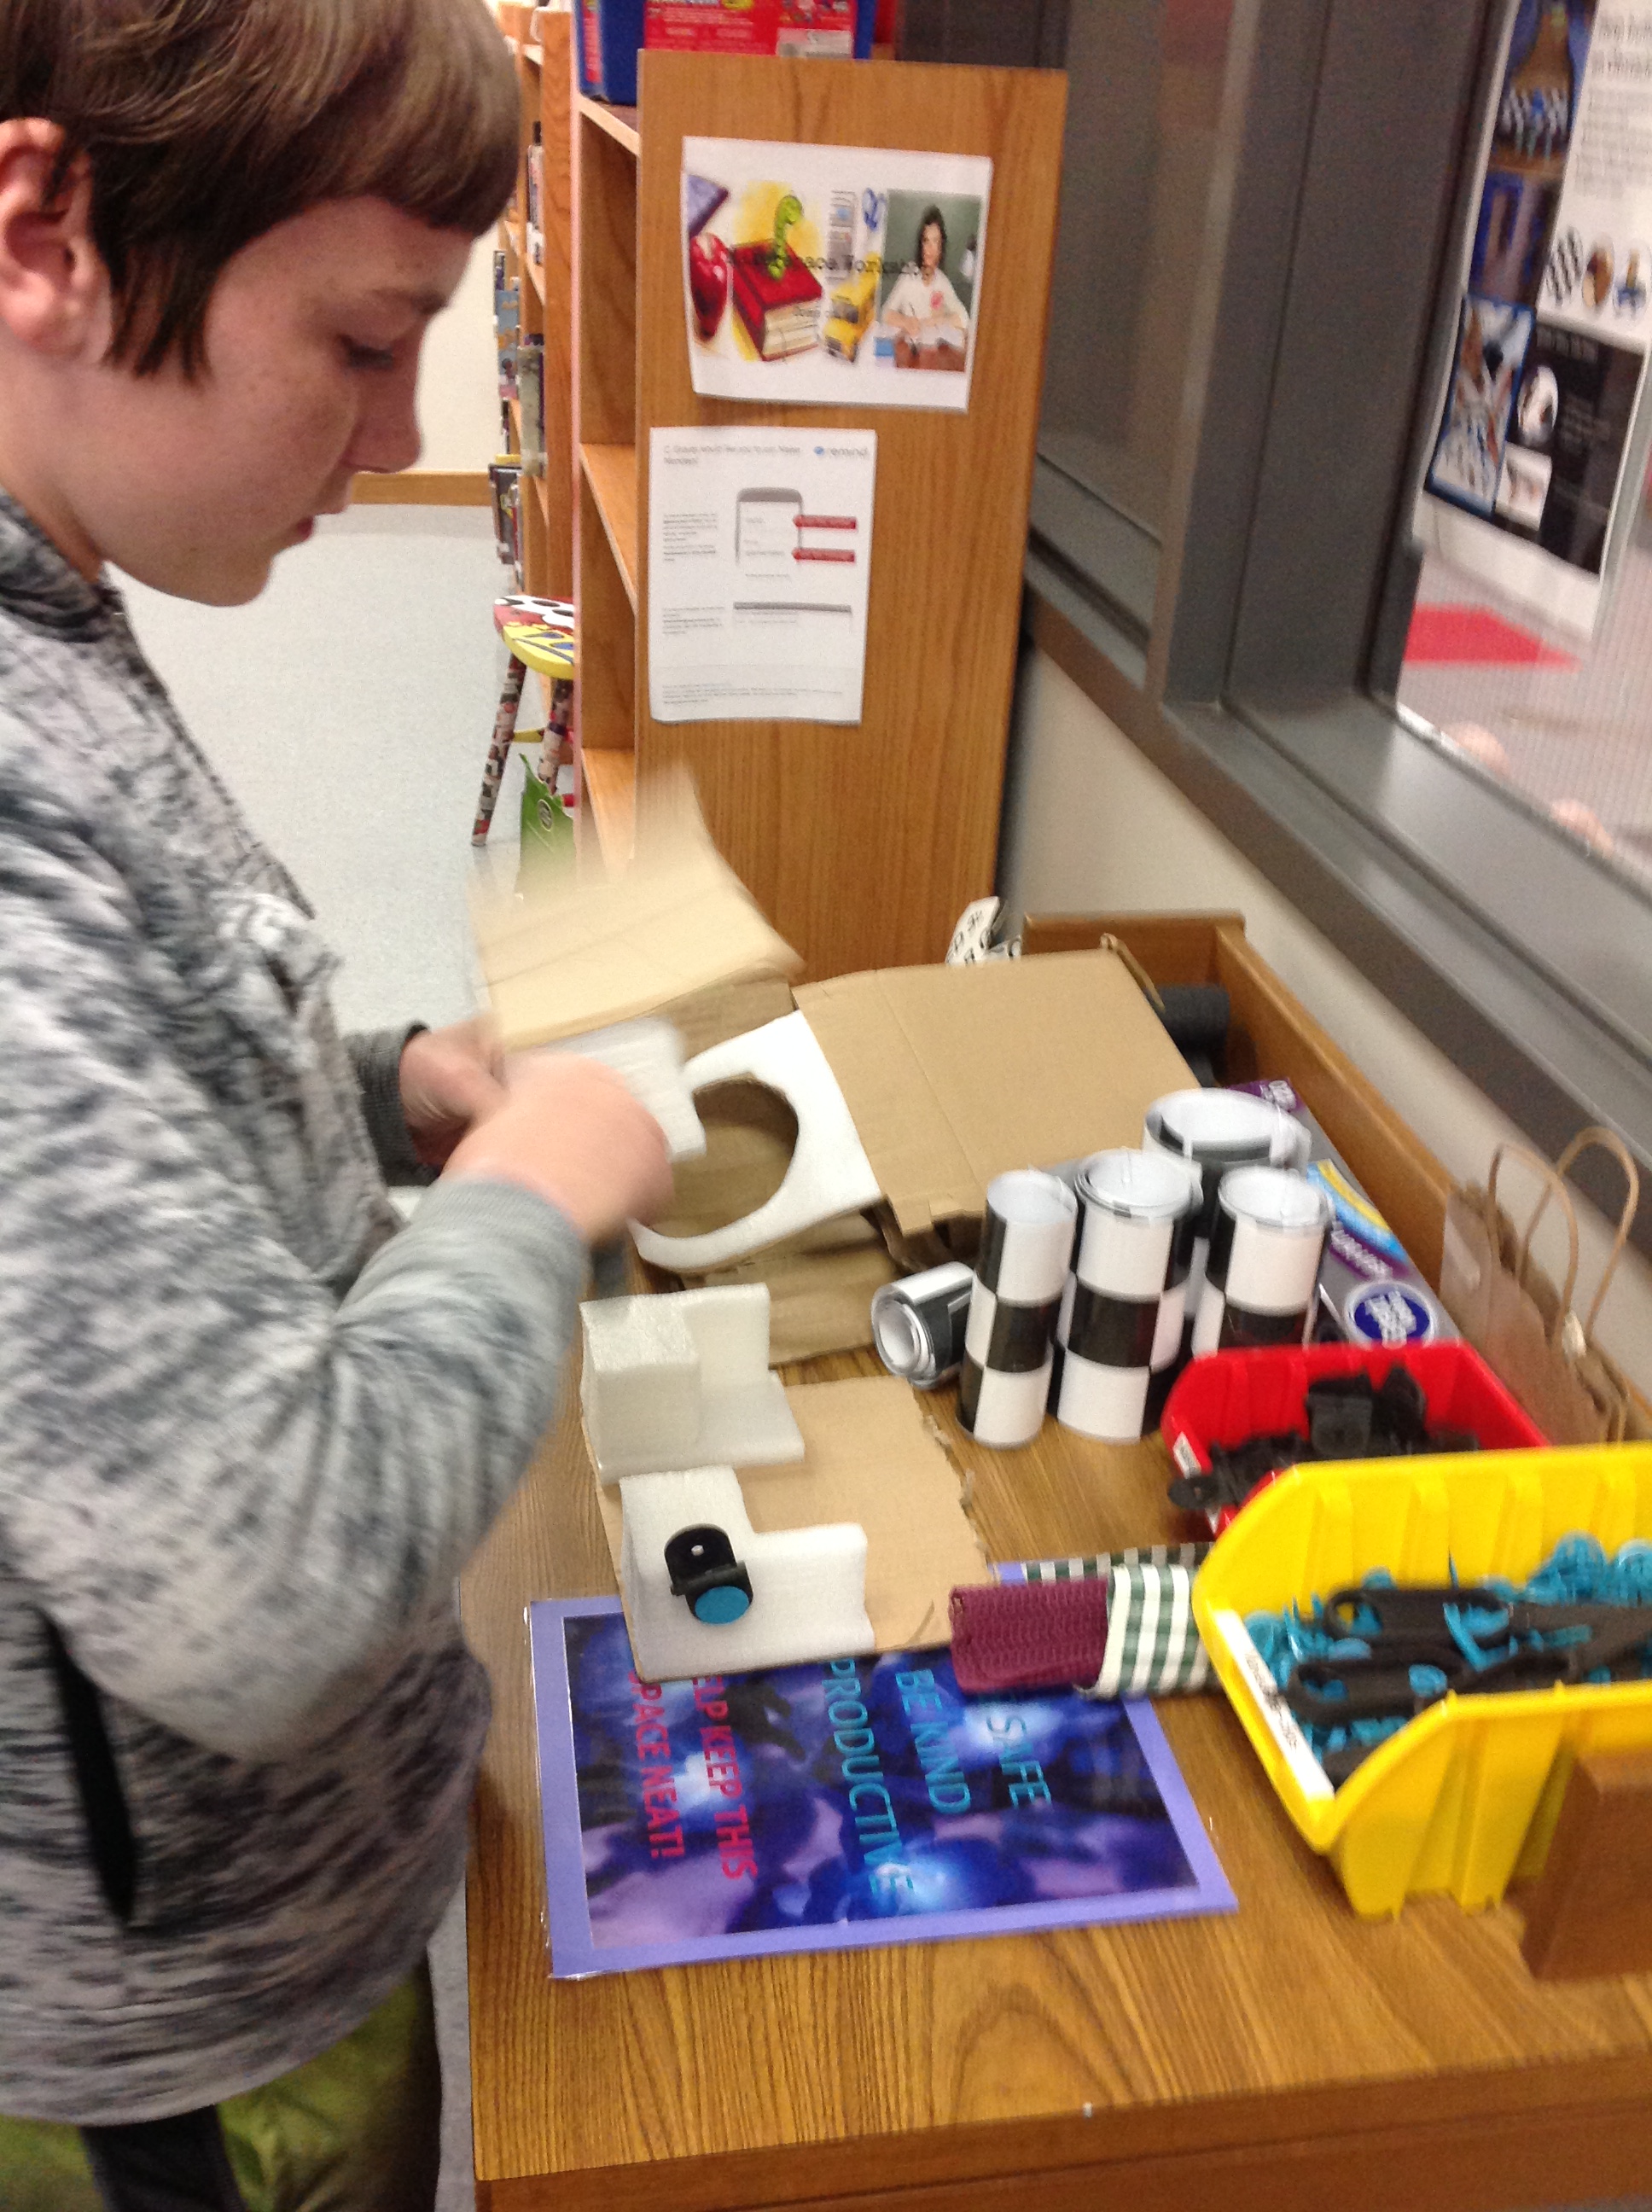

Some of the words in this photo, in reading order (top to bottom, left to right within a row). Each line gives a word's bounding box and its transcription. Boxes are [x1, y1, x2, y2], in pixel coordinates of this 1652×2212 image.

[692, 1674, 729, 1720] ELP
[896, 1669, 942, 1715] BE
[700, 1726, 742, 1800] KEEP
[822, 1658, 916, 1895] PRODUCTIVE
[910, 1721, 971, 1814] KIND
[986, 1714, 1053, 1811] SAFE
[641, 1765, 685, 1859] NEAT!
[714, 1803, 758, 1880] THIS
